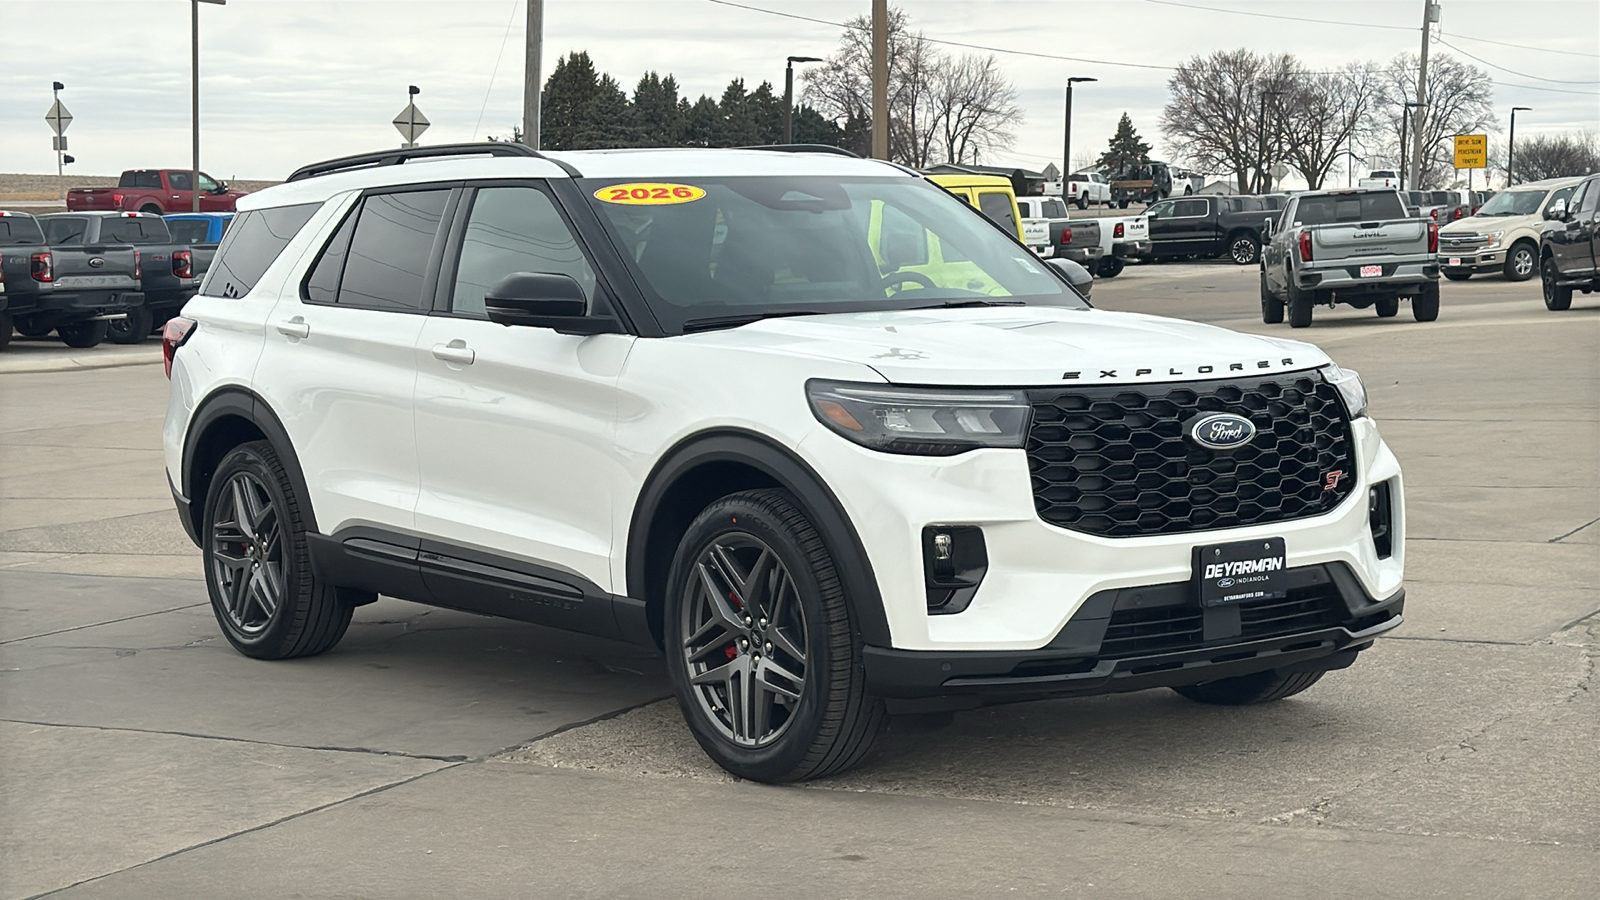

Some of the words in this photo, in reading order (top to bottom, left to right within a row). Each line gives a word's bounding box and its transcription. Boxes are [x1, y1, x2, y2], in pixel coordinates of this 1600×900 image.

[610, 187, 694, 201] 2026
[1129, 223, 1145, 231] RAM
[1353, 230, 1388, 239] GMC
[1062, 357, 1294, 380] EXPLORER
[1209, 420, 1245, 441] Ford
[1324, 470, 1343, 491] ST
[1204, 556, 1284, 579] DEYARMAN
[1236, 575, 1270, 584] INDIANOLA
